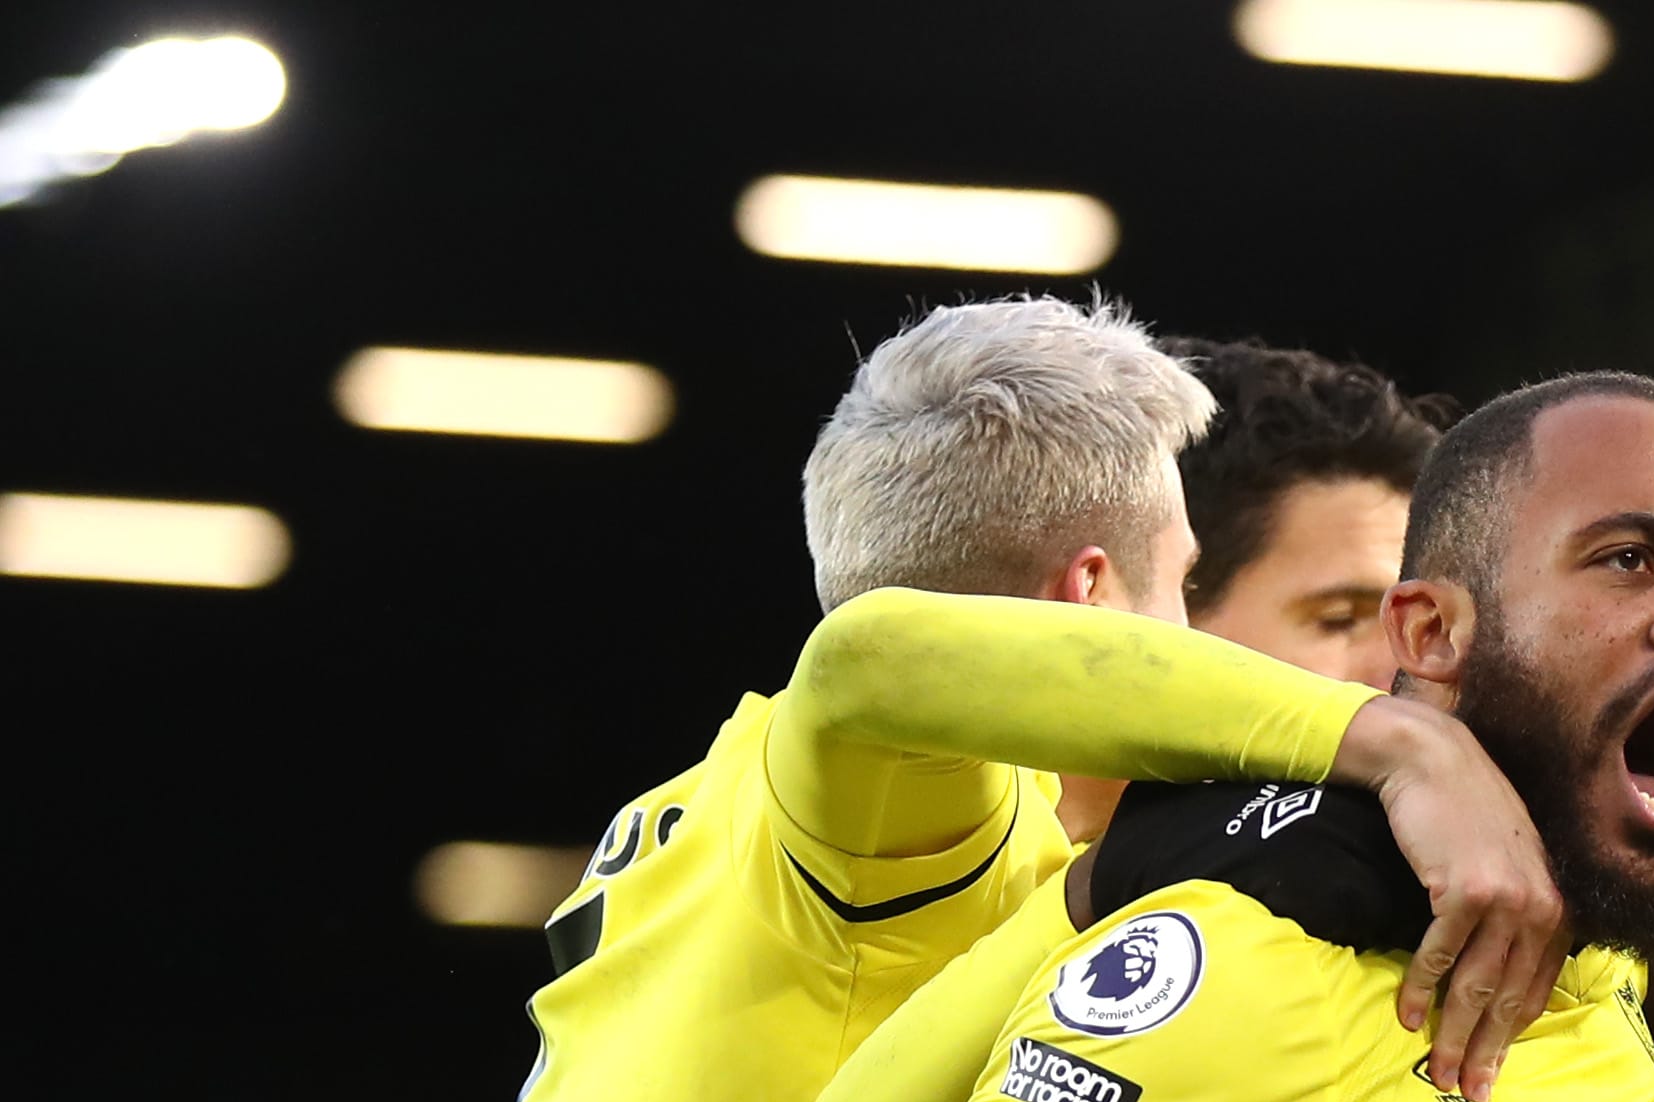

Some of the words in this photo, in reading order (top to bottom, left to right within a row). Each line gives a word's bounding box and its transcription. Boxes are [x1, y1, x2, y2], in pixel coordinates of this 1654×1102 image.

[1086, 1006, 1134, 1020] Premier
[1135, 977, 1175, 1014] League
[1011, 1037, 1043, 1072] No
[1000, 1065, 1033, 1098] for
